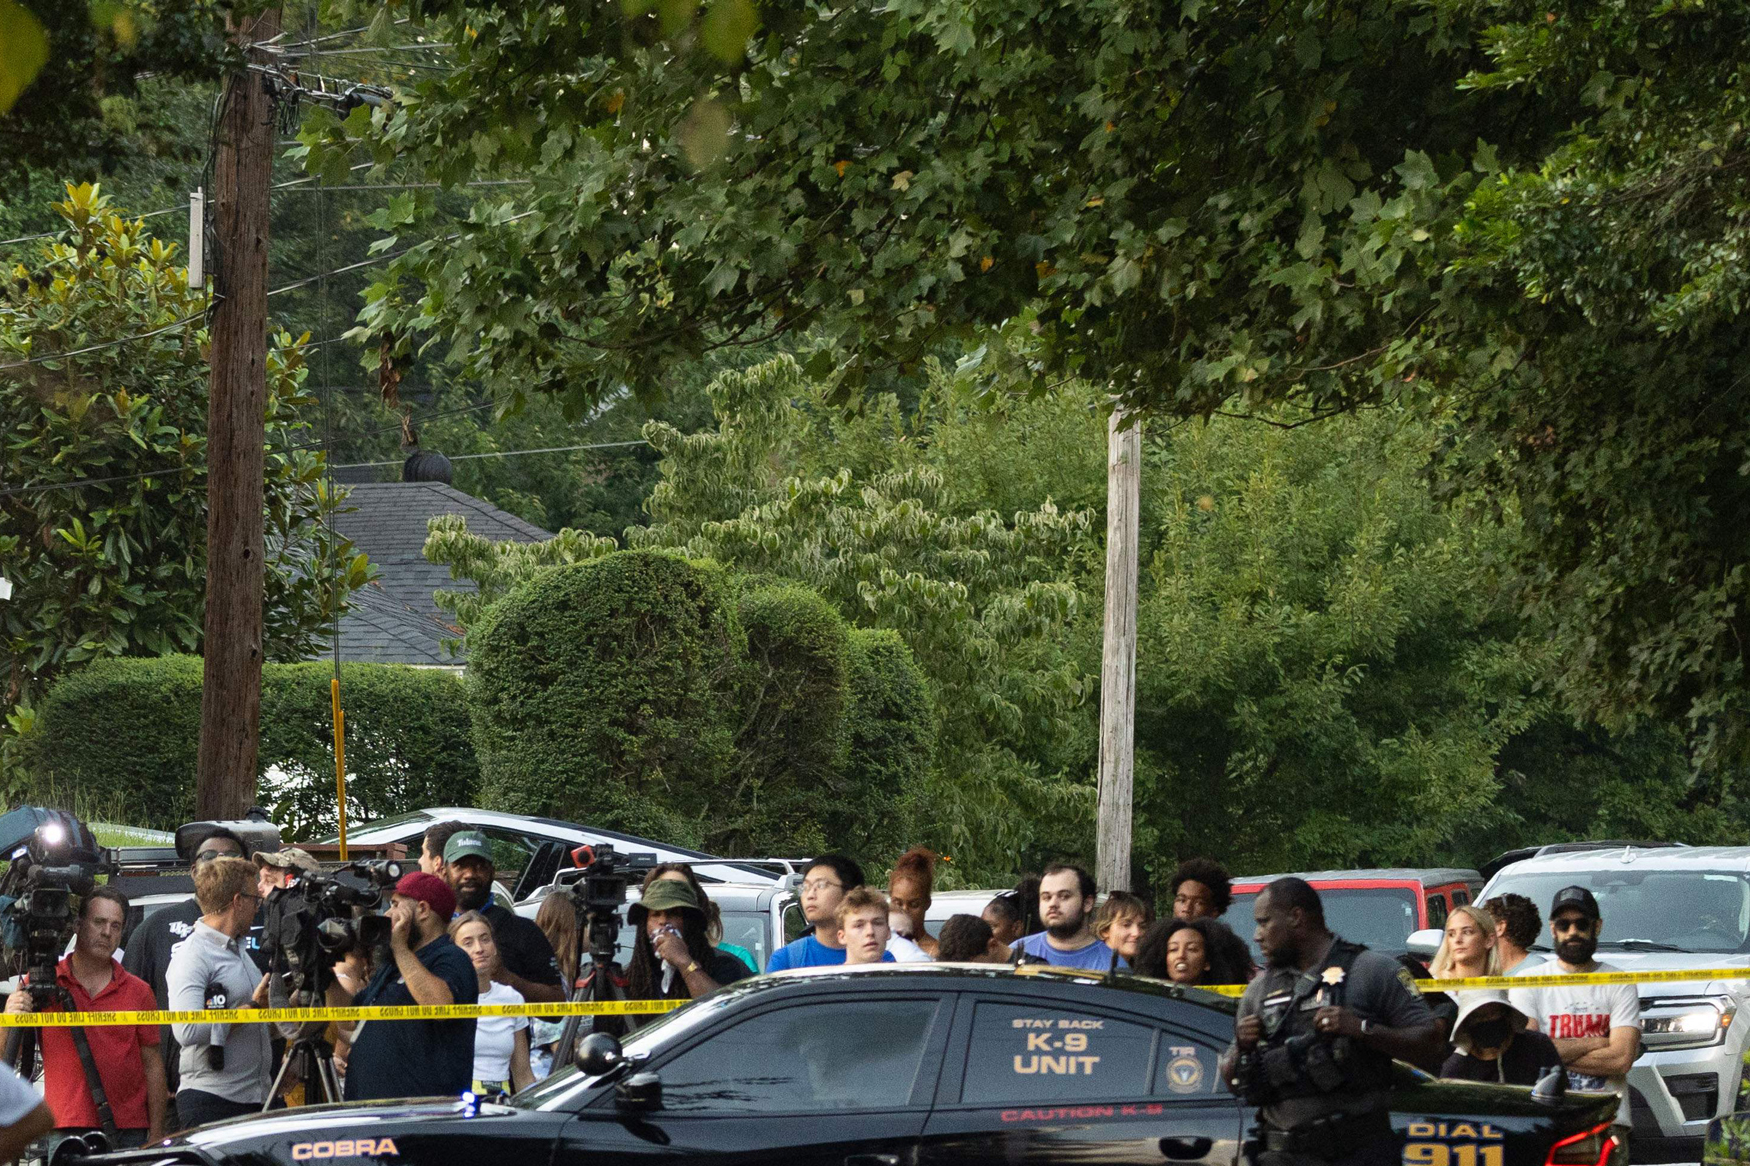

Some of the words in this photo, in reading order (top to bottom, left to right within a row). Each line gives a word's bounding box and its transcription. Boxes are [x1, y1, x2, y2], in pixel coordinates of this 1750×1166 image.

[213, 994, 226, 1005] 10
[1012, 1019, 1053, 1028] STAY
[1058, 1019, 1103, 1030] BACK
[1027, 1032, 1089, 1052] K-9
[1013, 1055, 1100, 1075] UNIT
[1001, 1106, 1114, 1122] CAUTION
[1121, 1104, 1163, 1116] K-9
[1408, 1123, 1504, 1139] DIAL
[292, 1137, 400, 1161] COBRA
